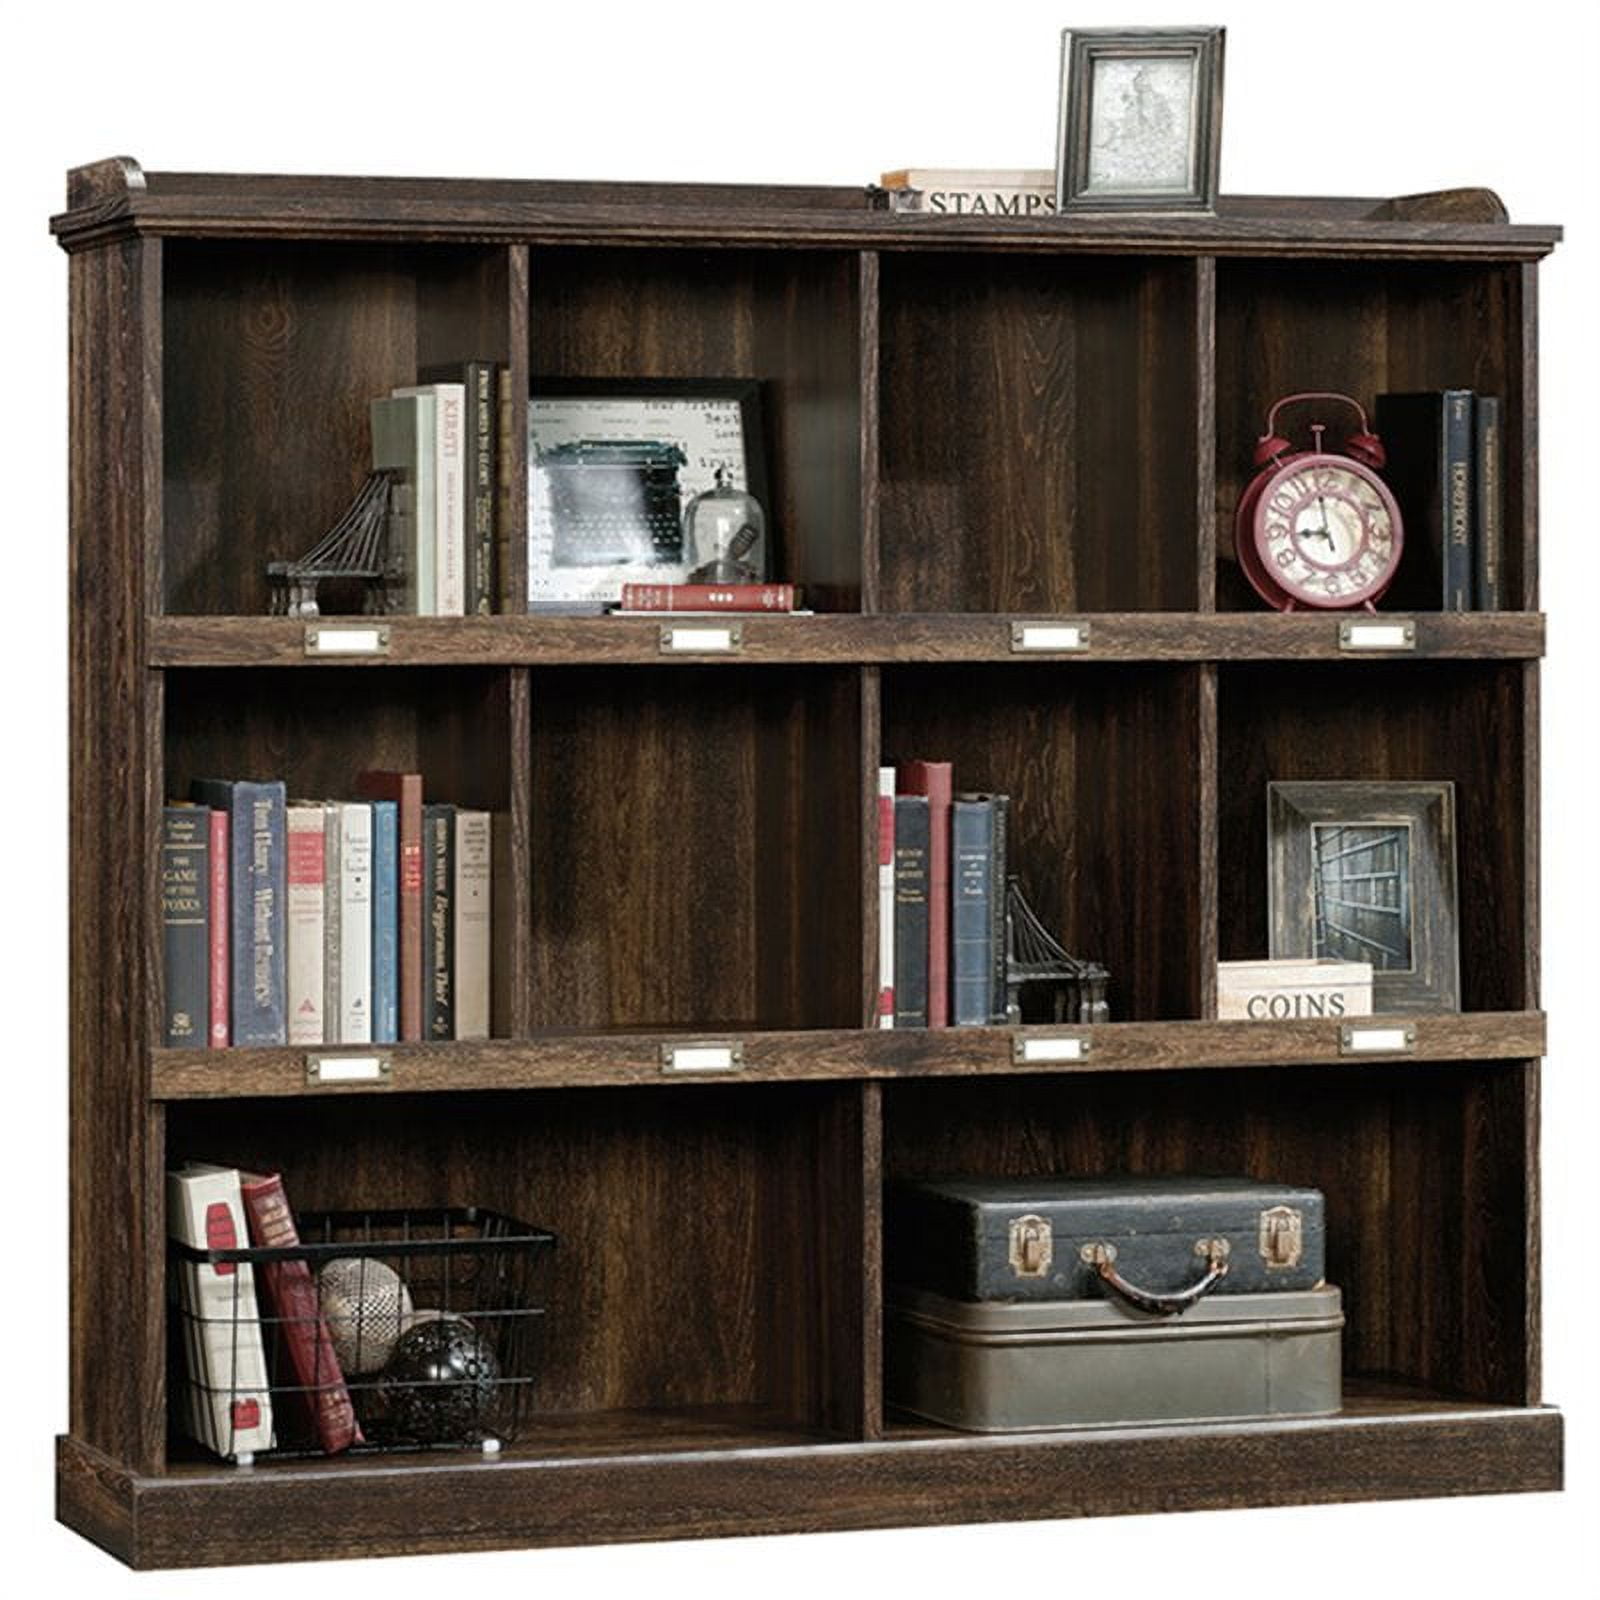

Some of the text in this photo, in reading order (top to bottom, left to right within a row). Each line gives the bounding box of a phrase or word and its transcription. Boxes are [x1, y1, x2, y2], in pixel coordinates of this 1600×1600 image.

[929, 192, 1056, 215] STAMPS
[443, 398, 459, 458] KIRSTI
[1265, 522, 1288, 541] 9
[1276, 547, 1297, 569] 8
[1247, 993, 1345, 1019] COINS
